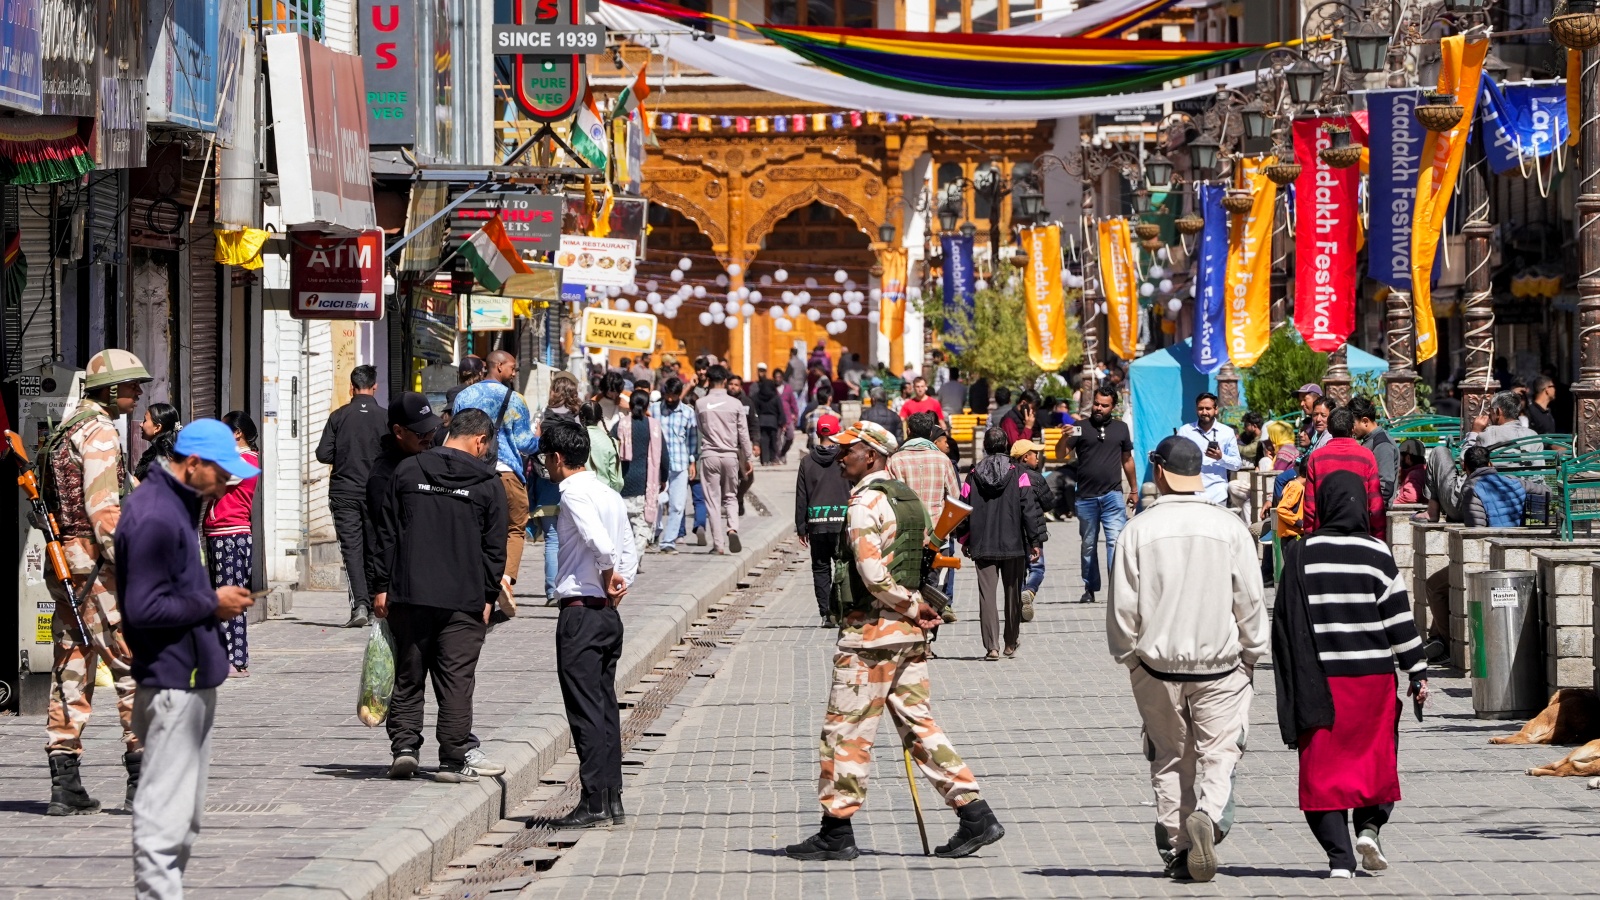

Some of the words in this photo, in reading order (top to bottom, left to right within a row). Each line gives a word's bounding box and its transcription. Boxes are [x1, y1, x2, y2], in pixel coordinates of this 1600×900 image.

[498, 31, 552, 47] SINCE
[556, 31, 598, 47] 1939
[531, 77, 566, 89] PURE
[367, 91, 408, 104] PURE
[535, 93, 563, 105] VEG
[372, 107, 404, 119] VEG
[1391, 94, 1420, 182] Laadakh
[485, 200, 510, 209] WAY
[512, 200, 529, 209] TO
[1238, 166, 1259, 266] Ladakh
[1391, 187, 1417, 280] Festival
[582, 241, 631, 250] RESTAURANT
[306, 244, 372, 269] ATM
[1032, 231, 1050, 301] Laadakh
[561, 292, 582, 300] GEAR
[1313, 241, 1338, 341] Festival
[317, 300, 344, 308] ICICI
[345, 300, 369, 309] Bank
[593, 316, 617, 327] TAXI
[1232, 272, 1253, 361] Festival
[591, 328, 635, 341] SERVICE
[1037, 303, 1057, 364] Festival
[417, 483, 431, 491] THE
[452, 488, 470, 497] FACE
